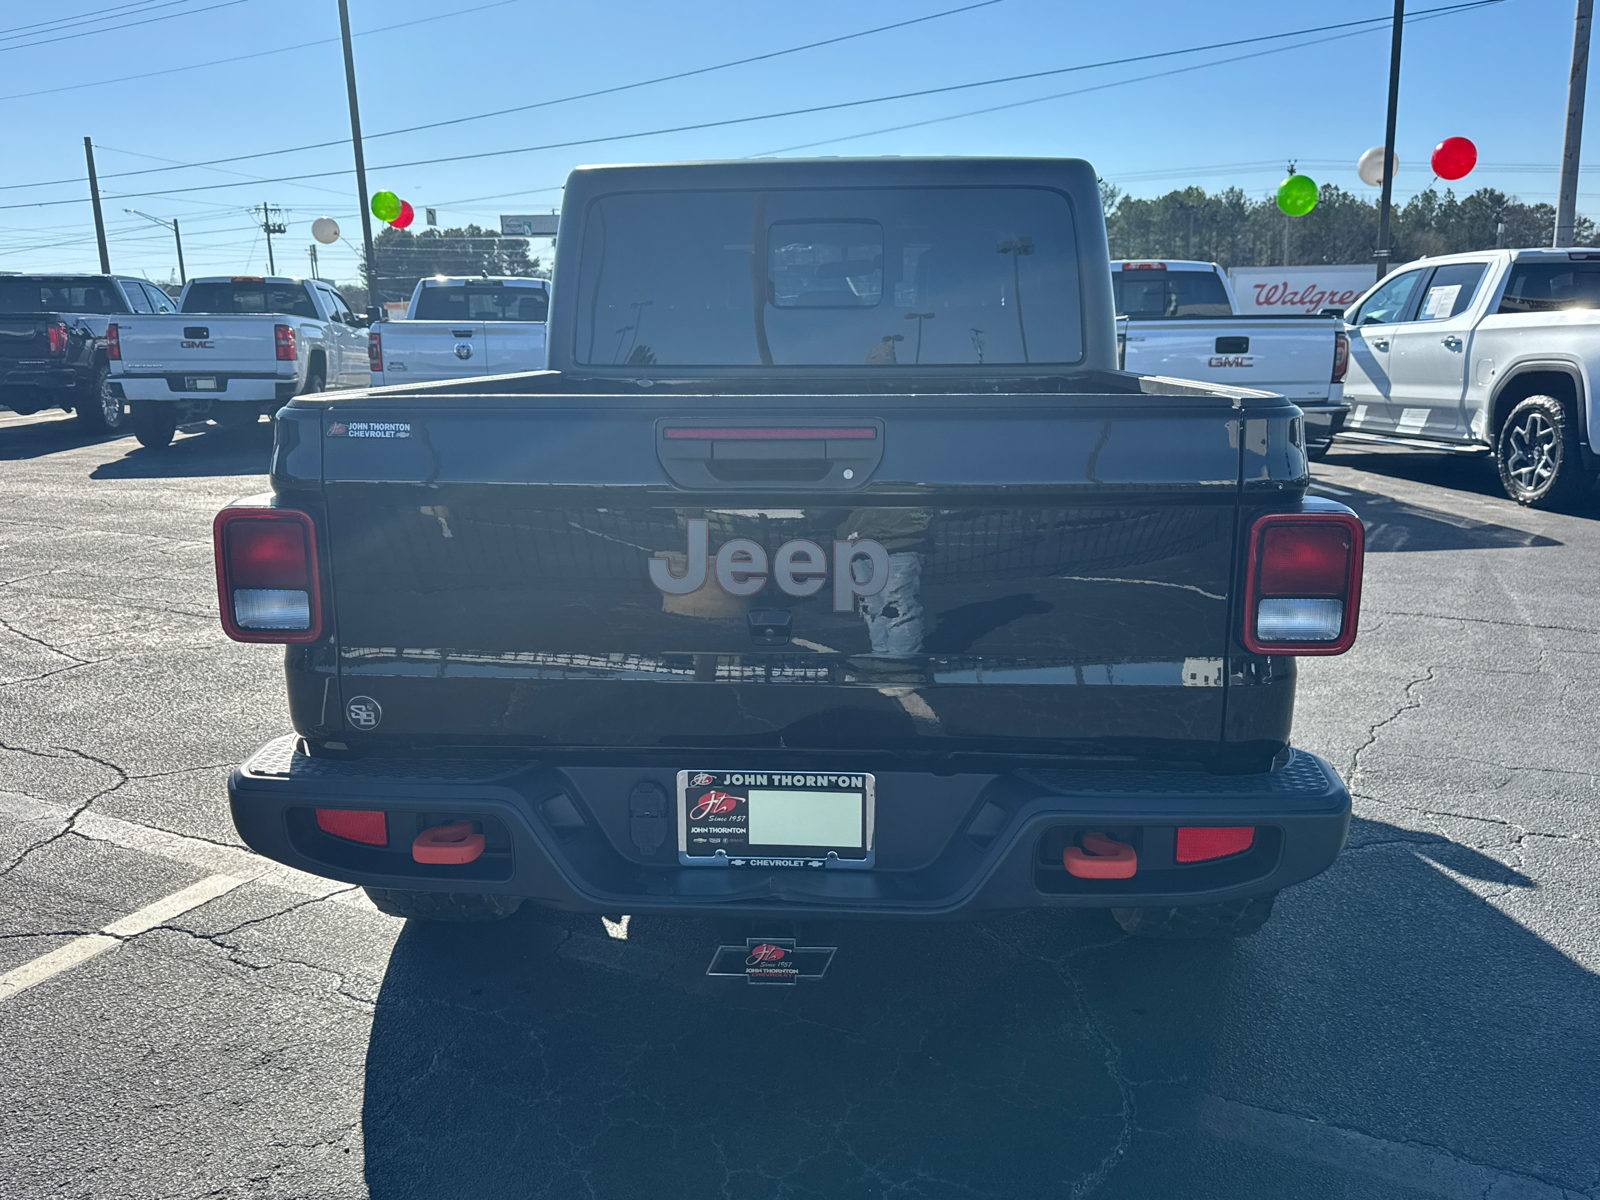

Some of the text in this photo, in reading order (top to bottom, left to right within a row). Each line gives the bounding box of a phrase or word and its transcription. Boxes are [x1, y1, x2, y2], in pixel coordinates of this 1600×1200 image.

[180, 341, 215, 349] GMC
[1208, 356, 1254, 368] GMC
[348, 422, 410, 431] JOHN THORNTON
[348, 430, 395, 438] CHEVROLET
[648, 518, 890, 613] Jeep
[723, 774, 863, 788] JOHN THORNTON
[750, 859, 804, 867] CHEVROLET
